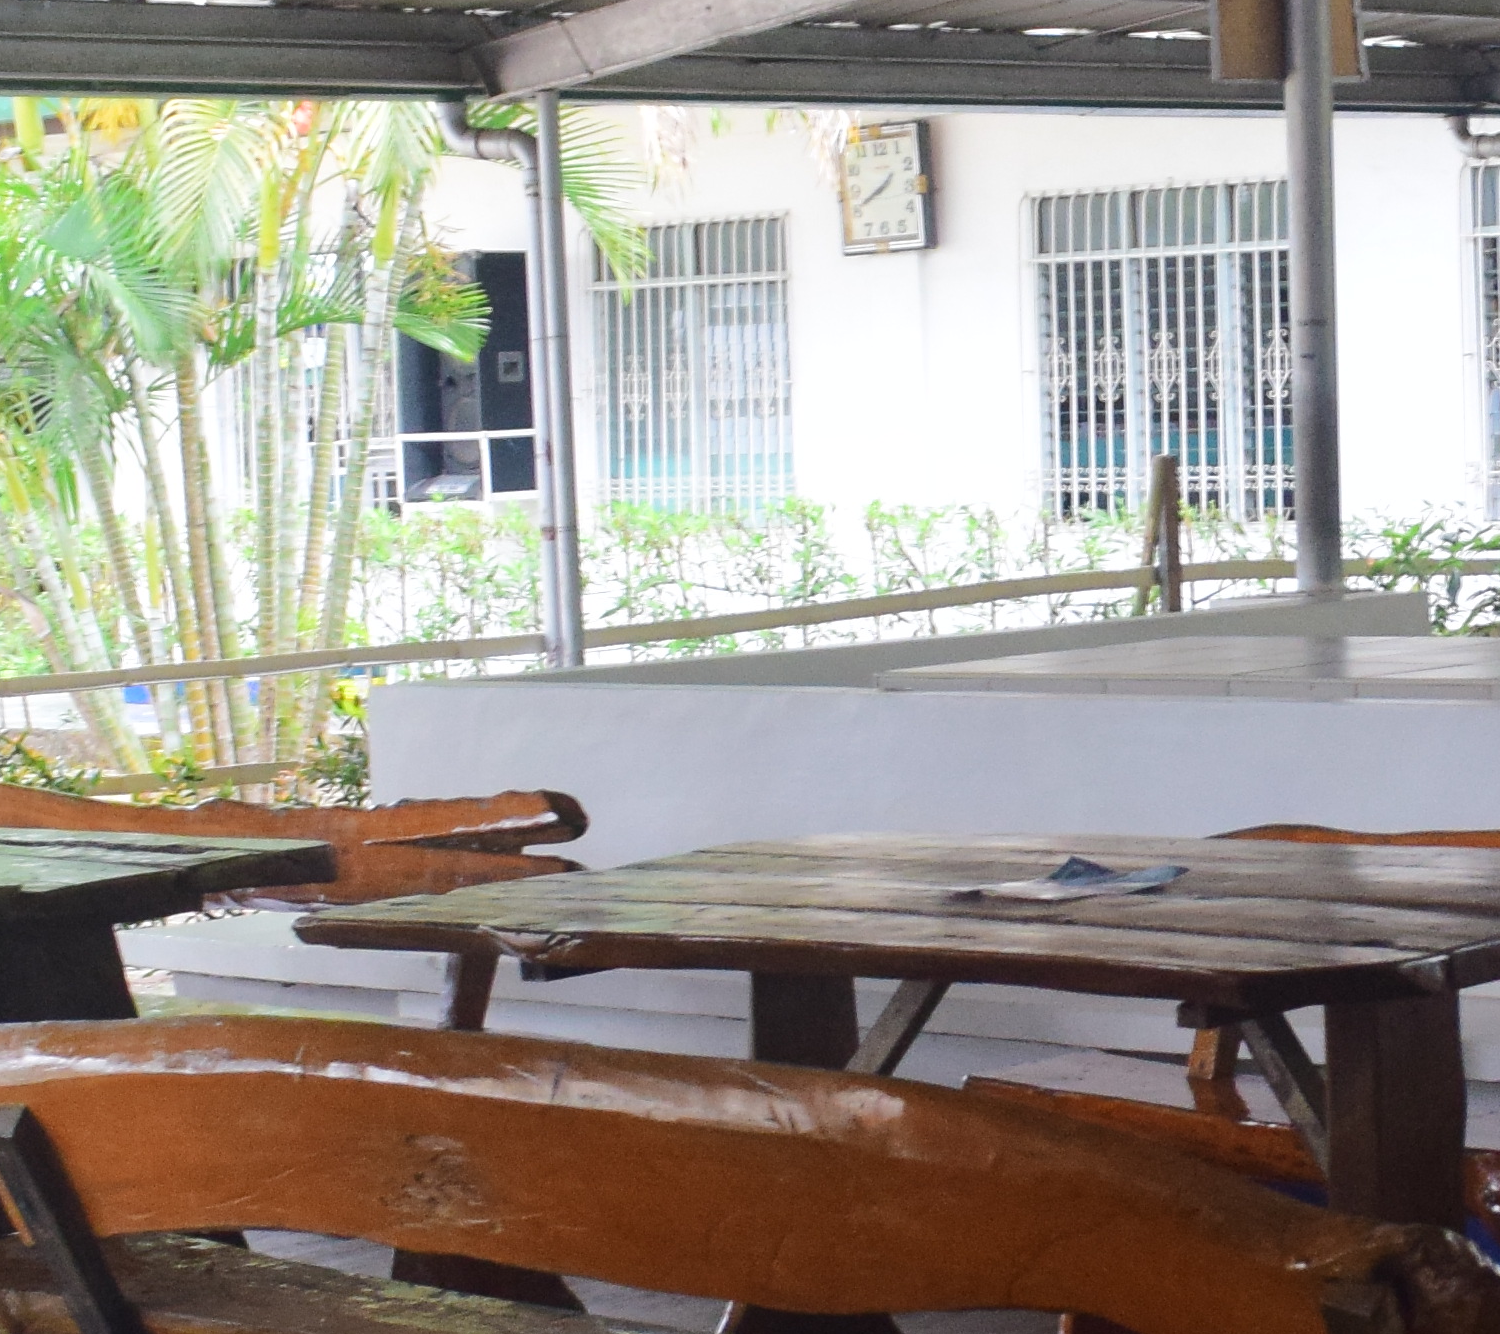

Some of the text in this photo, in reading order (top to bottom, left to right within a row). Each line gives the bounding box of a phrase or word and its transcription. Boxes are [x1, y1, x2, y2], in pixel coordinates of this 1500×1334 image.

[874, 142, 887, 155] 12
[894, 140, 900, 154] 1
[903, 156, 913, 171] 2
[851, 184, 861, 197] 9
[904, 178, 914, 192] 3
[906, 199, 915, 213] 4
[864, 222, 873, 236] 7
[880, 220, 890, 235] 6
[897, 219, 907, 233] 5
